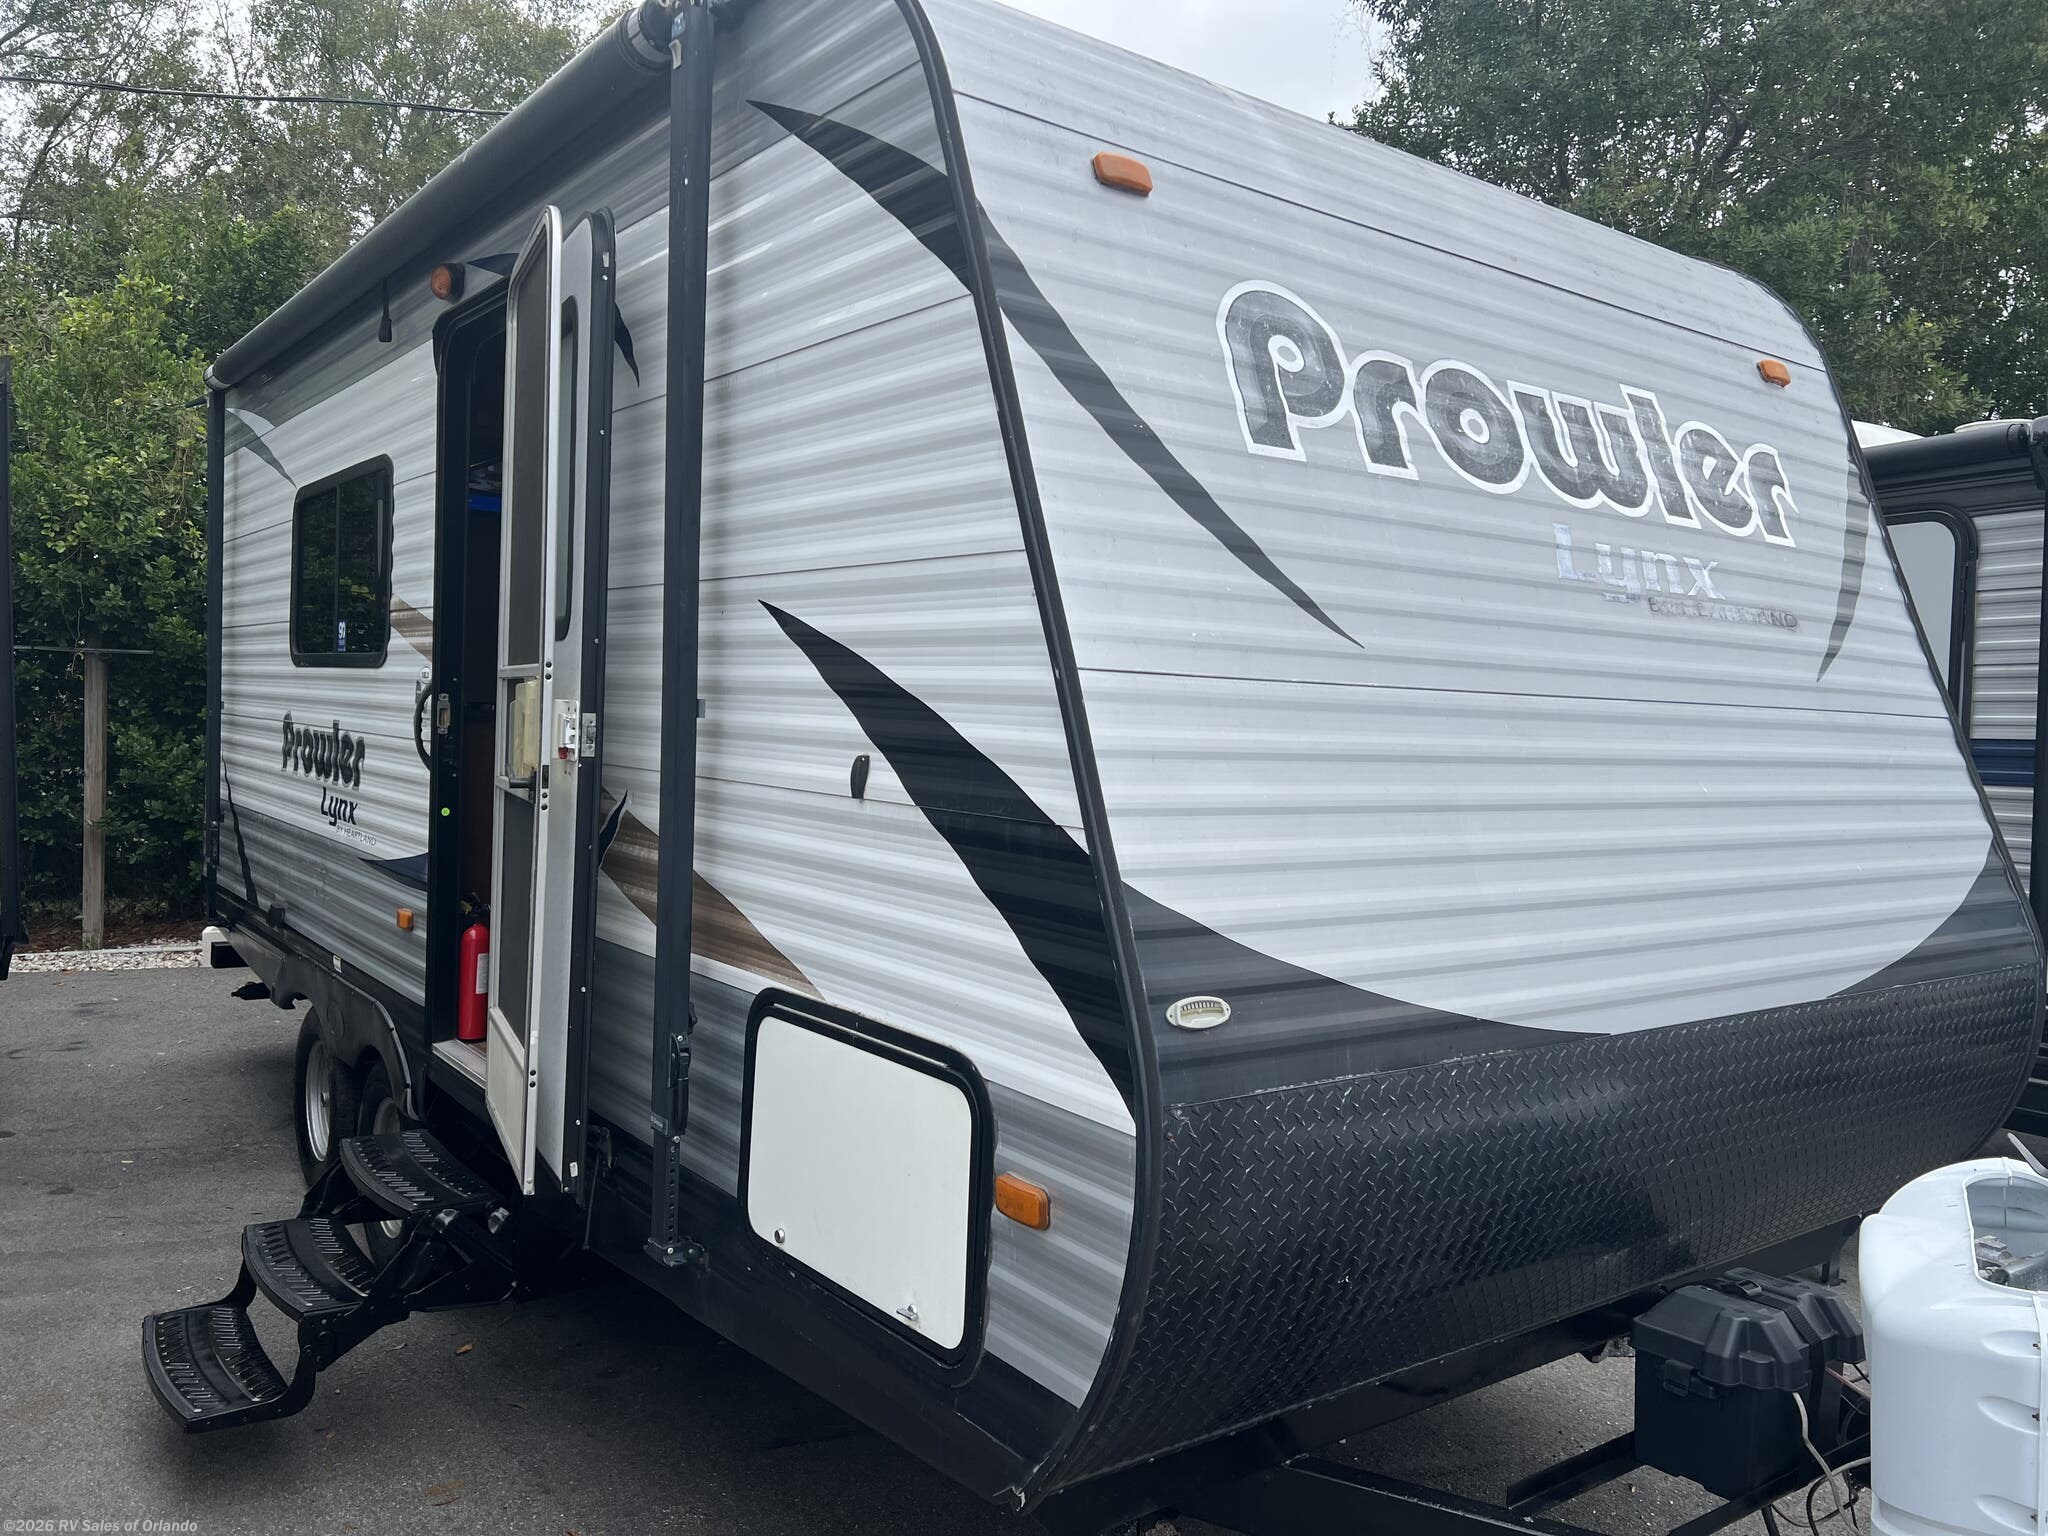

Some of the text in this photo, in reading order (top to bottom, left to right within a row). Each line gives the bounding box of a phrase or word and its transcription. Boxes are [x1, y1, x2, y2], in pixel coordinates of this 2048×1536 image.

[1216, 279, 1799, 547] Prowler
[1552, 522, 1726, 603] Lynx
[281, 711, 365, 792] Prowler
[320, 786, 358, 827] Lynx
